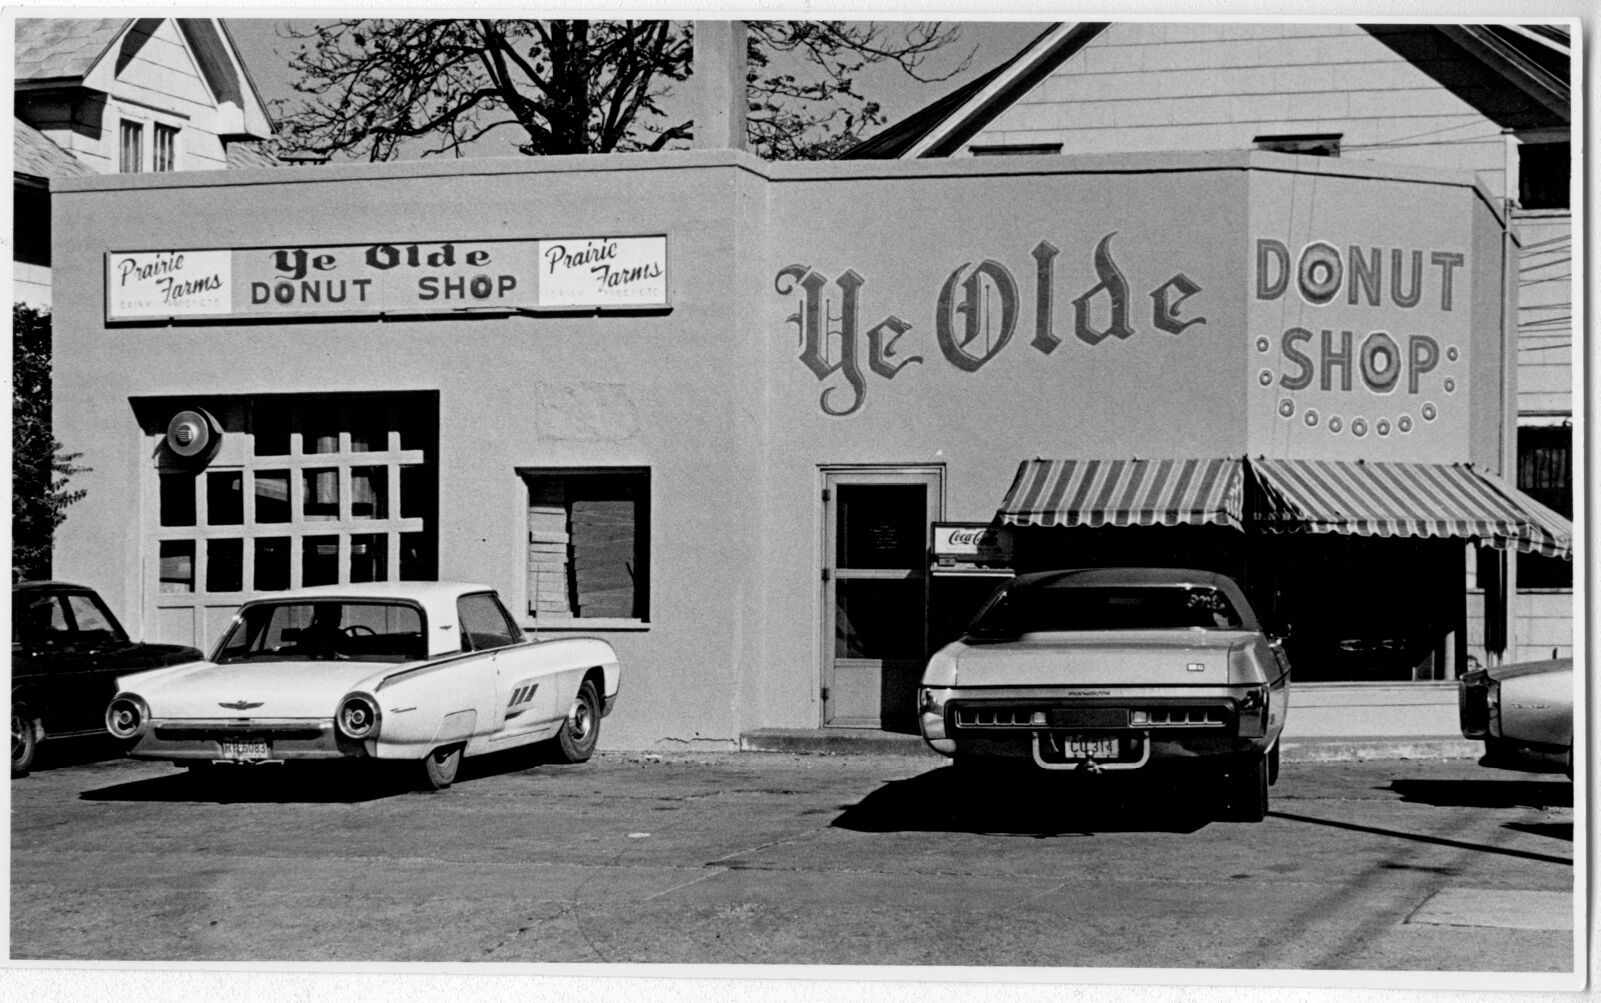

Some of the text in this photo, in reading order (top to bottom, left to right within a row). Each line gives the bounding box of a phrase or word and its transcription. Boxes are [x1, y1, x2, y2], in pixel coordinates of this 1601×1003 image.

[118, 251, 184, 287] Prairie
[270, 243, 492, 280] Ye Olde
[544, 239, 618, 275] Prairie
[1255, 238, 1465, 312] DONUT
[155, 273, 223, 304] Farms
[250, 273, 517, 305] DONUT SHOP
[588, 261, 663, 292] Farms
[774, 231, 1207, 417] Ye Olde
[1278, 326, 1440, 395] SHOP
